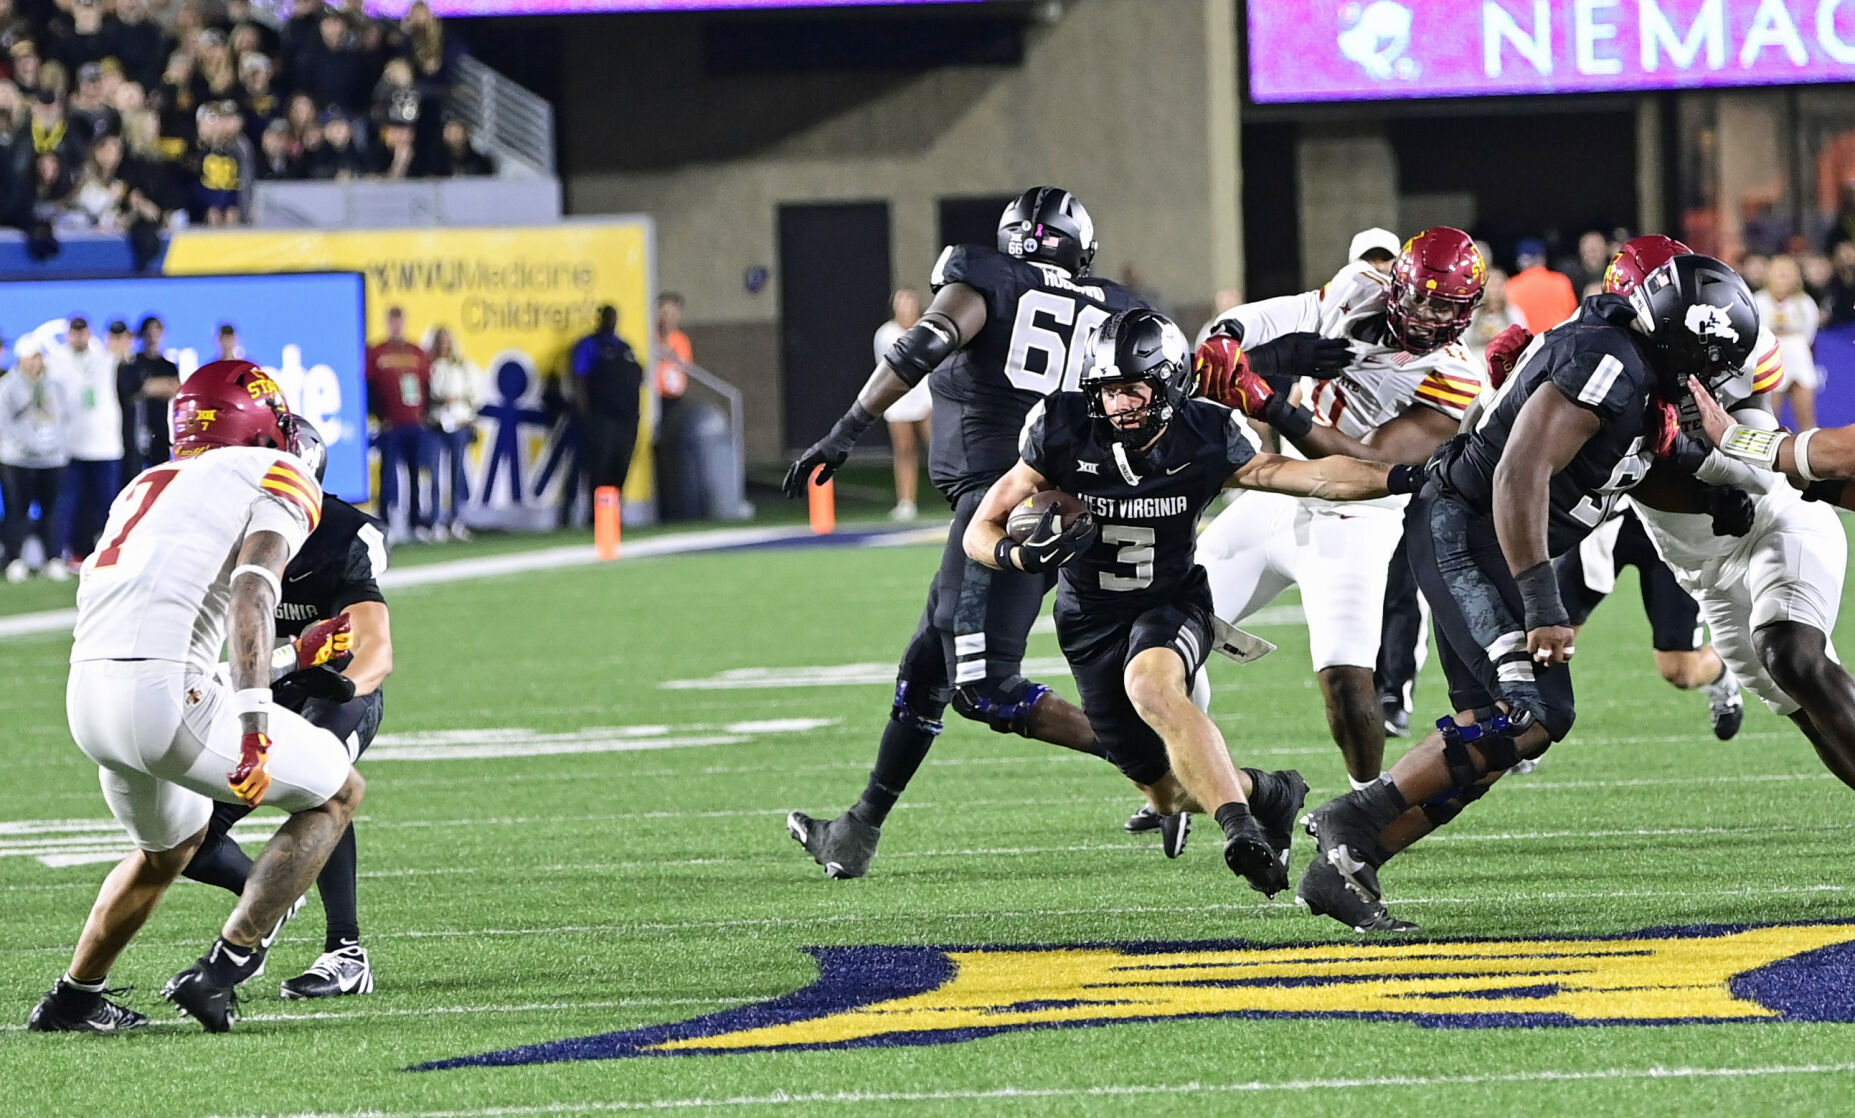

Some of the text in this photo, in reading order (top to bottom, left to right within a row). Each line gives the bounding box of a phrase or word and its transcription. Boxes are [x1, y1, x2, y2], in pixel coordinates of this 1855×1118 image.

[1008, 242, 1024, 255] 66
[201, 421, 210, 432] 7
[95, 468, 183, 570] 7
[1119, 496, 1187, 519] VIRGINIA
[1099, 523, 1156, 592] 3
